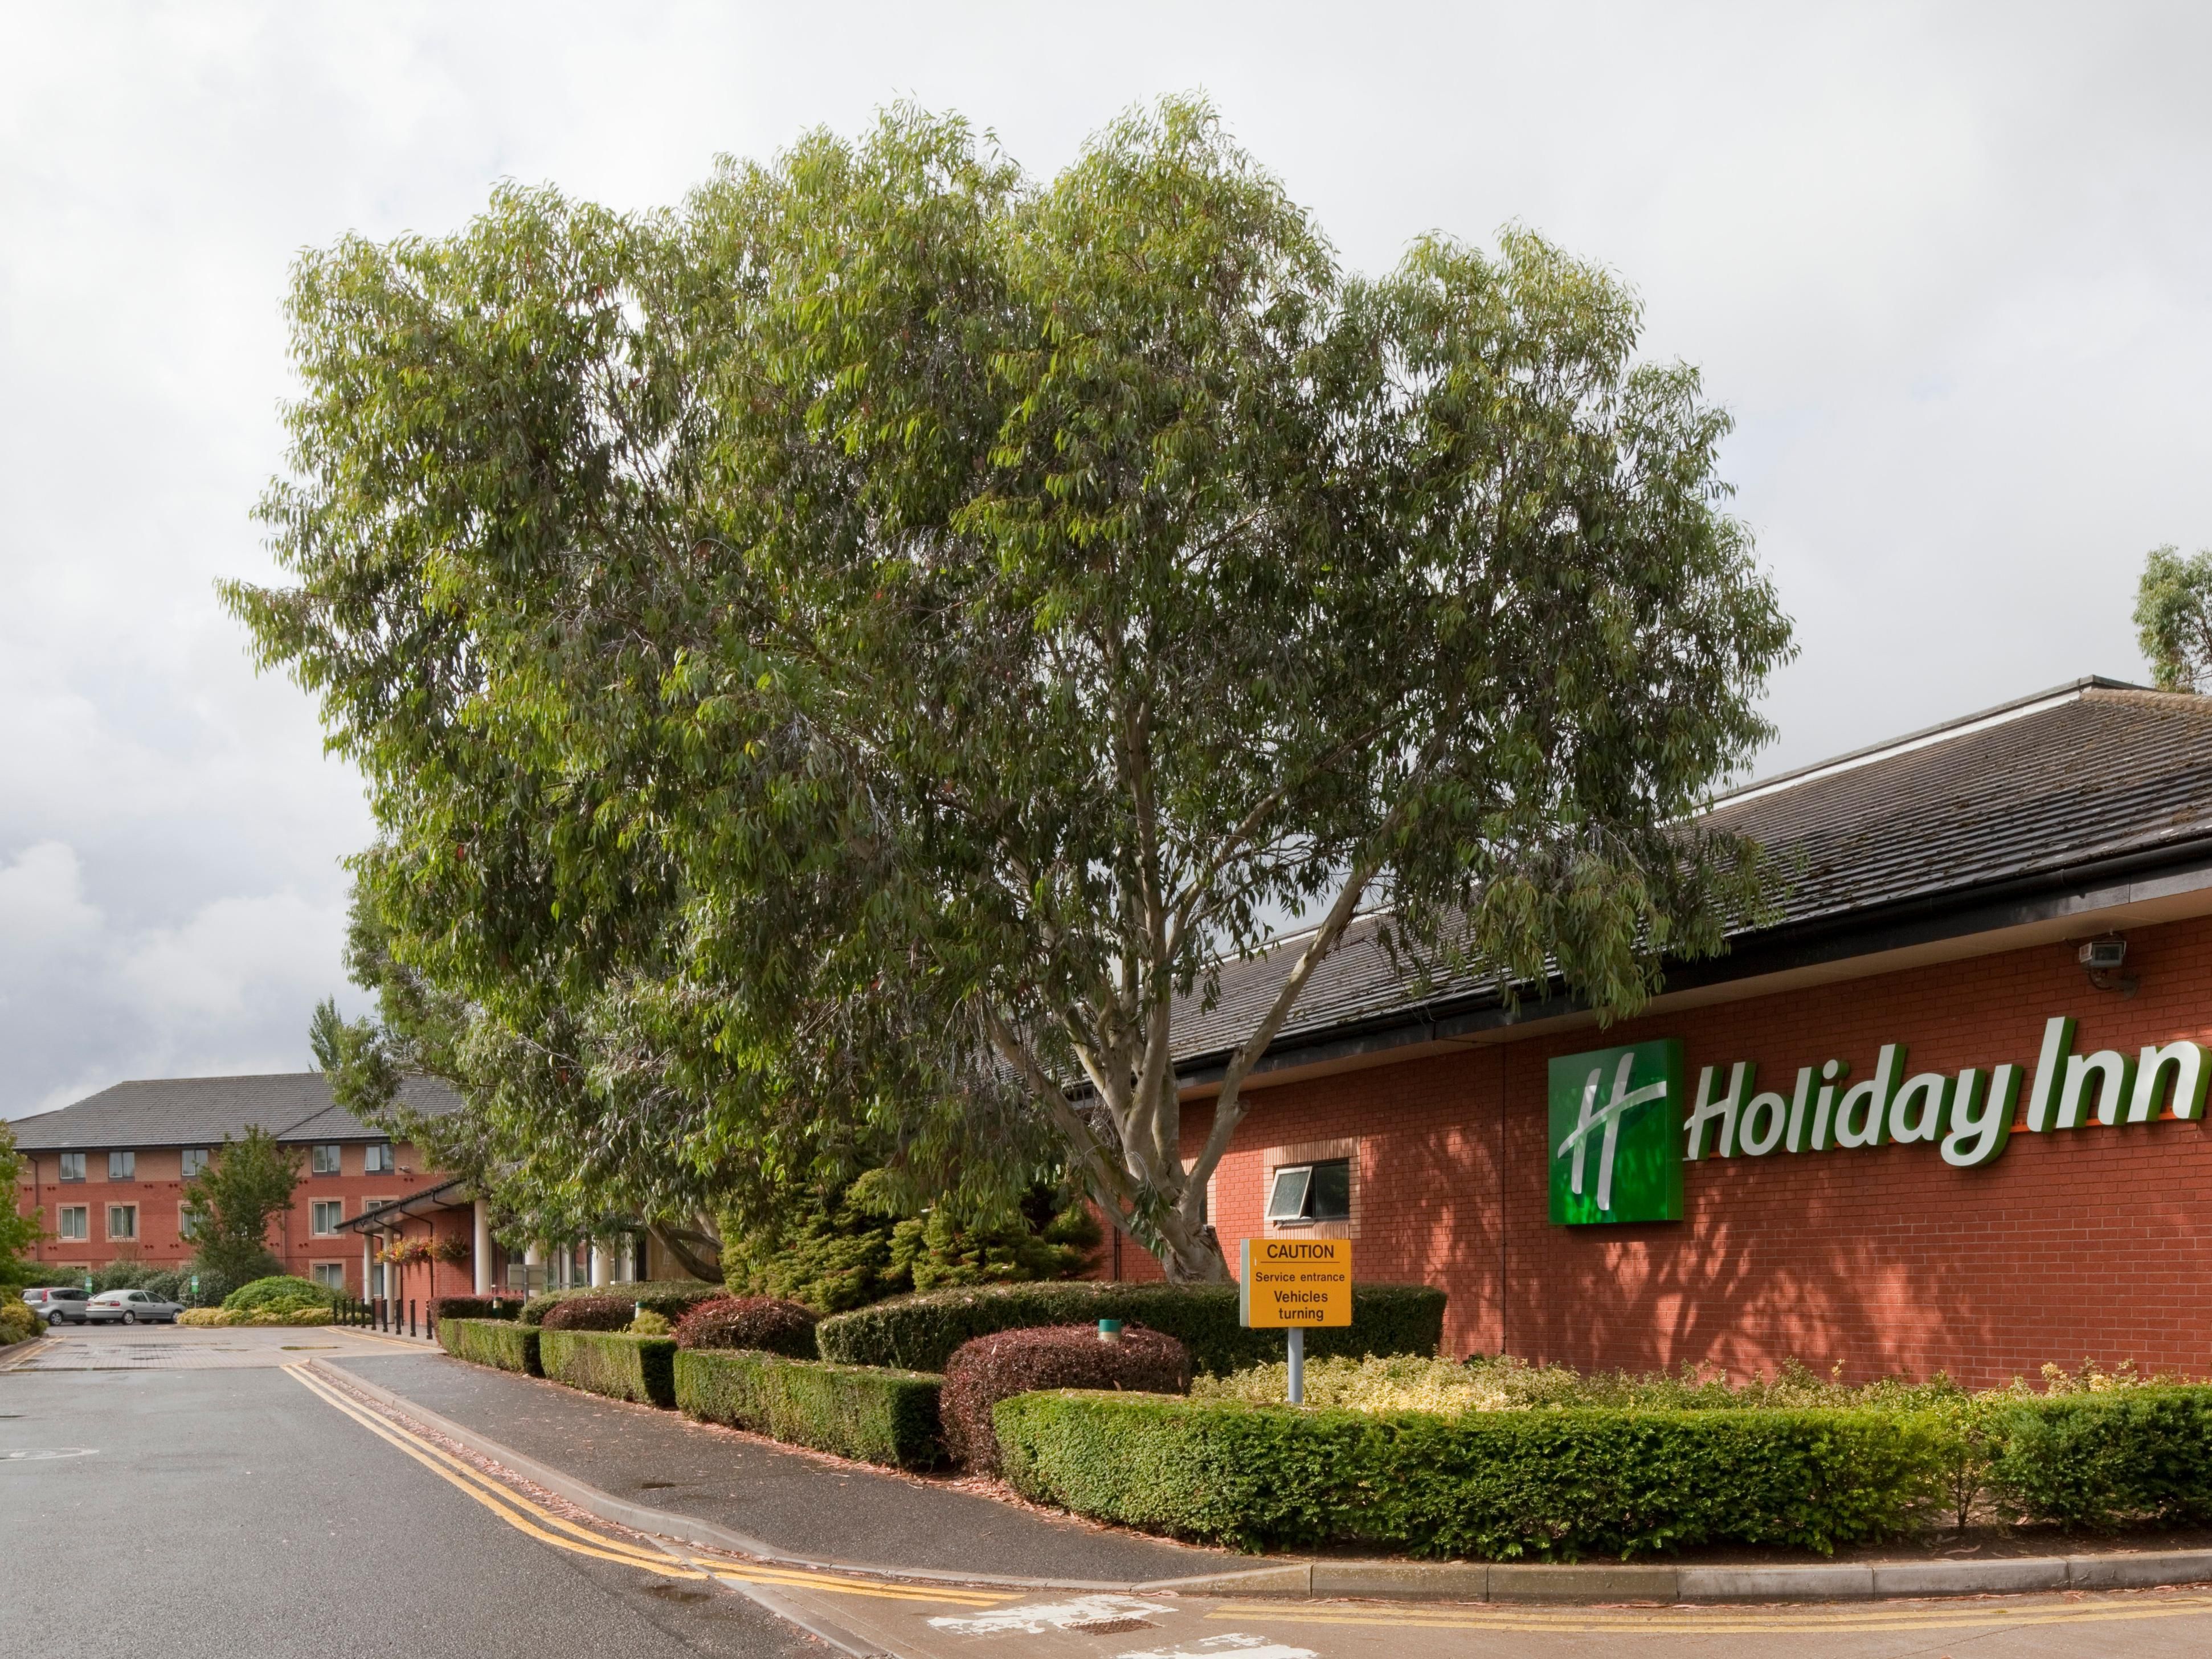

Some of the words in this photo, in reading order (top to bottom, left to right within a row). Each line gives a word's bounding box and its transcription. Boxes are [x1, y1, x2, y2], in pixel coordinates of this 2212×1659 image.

[1683, 1043, 2017, 1166] Holiday
[2026, 1016, 2206, 1133] Inn
[1267, 1244, 1334, 1258] CAUTION
[1256, 1272, 1295, 1282] Service
[1300, 1272, 1345, 1282] entrance
[1274, 1290, 1328, 1302] Vehicles
[1278, 1307, 1324, 1322] turning
